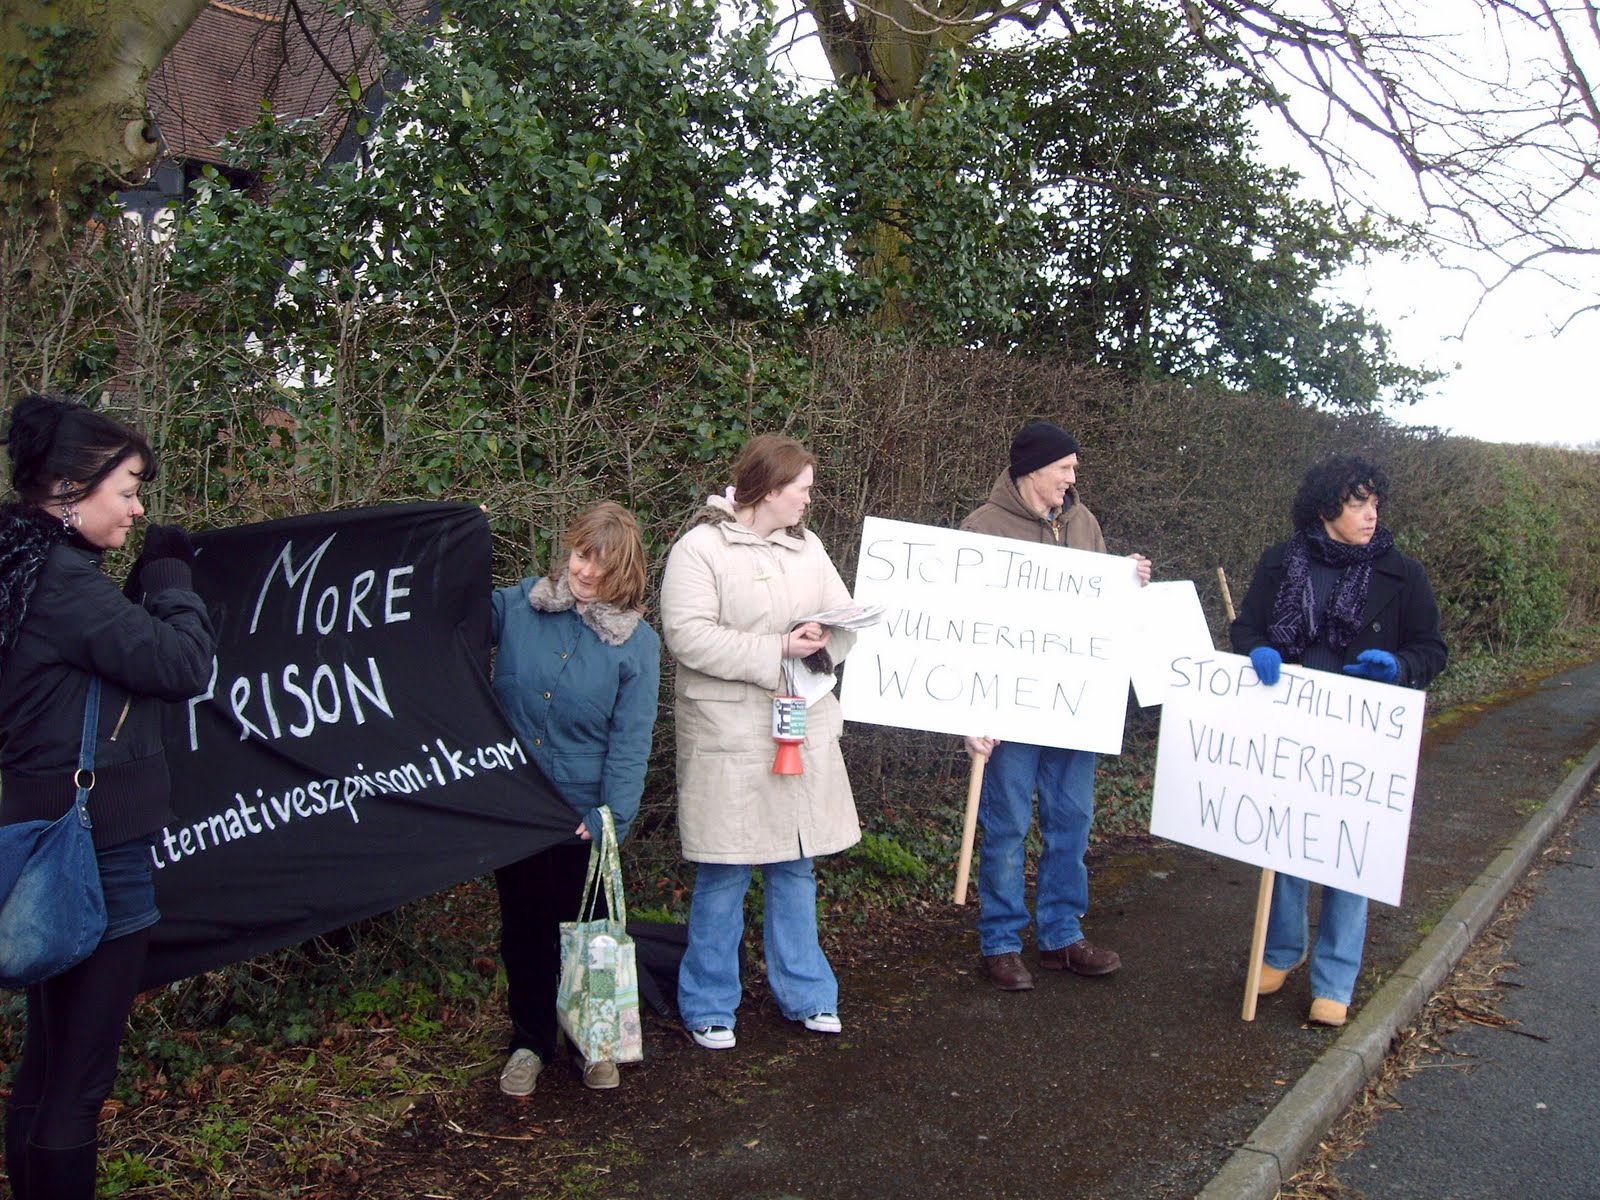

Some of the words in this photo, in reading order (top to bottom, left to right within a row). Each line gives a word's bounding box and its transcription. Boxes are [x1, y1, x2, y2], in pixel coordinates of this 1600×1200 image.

[249, 532, 415, 635] MORE
[866, 539, 984, 584] STOP
[986, 549, 1102, 599] JAILING
[887, 609, 1112, 660] VULNERABLE
[188, 654, 395, 752] PRISON
[876, 653, 1087, 716] WOMEN
[1170, 656, 1261, 697] STOP
[1272, 671, 1406, 740] JAILING
[1188, 719, 1408, 812] VULNERABLE
[1198, 780, 1371, 880] WOMEN
